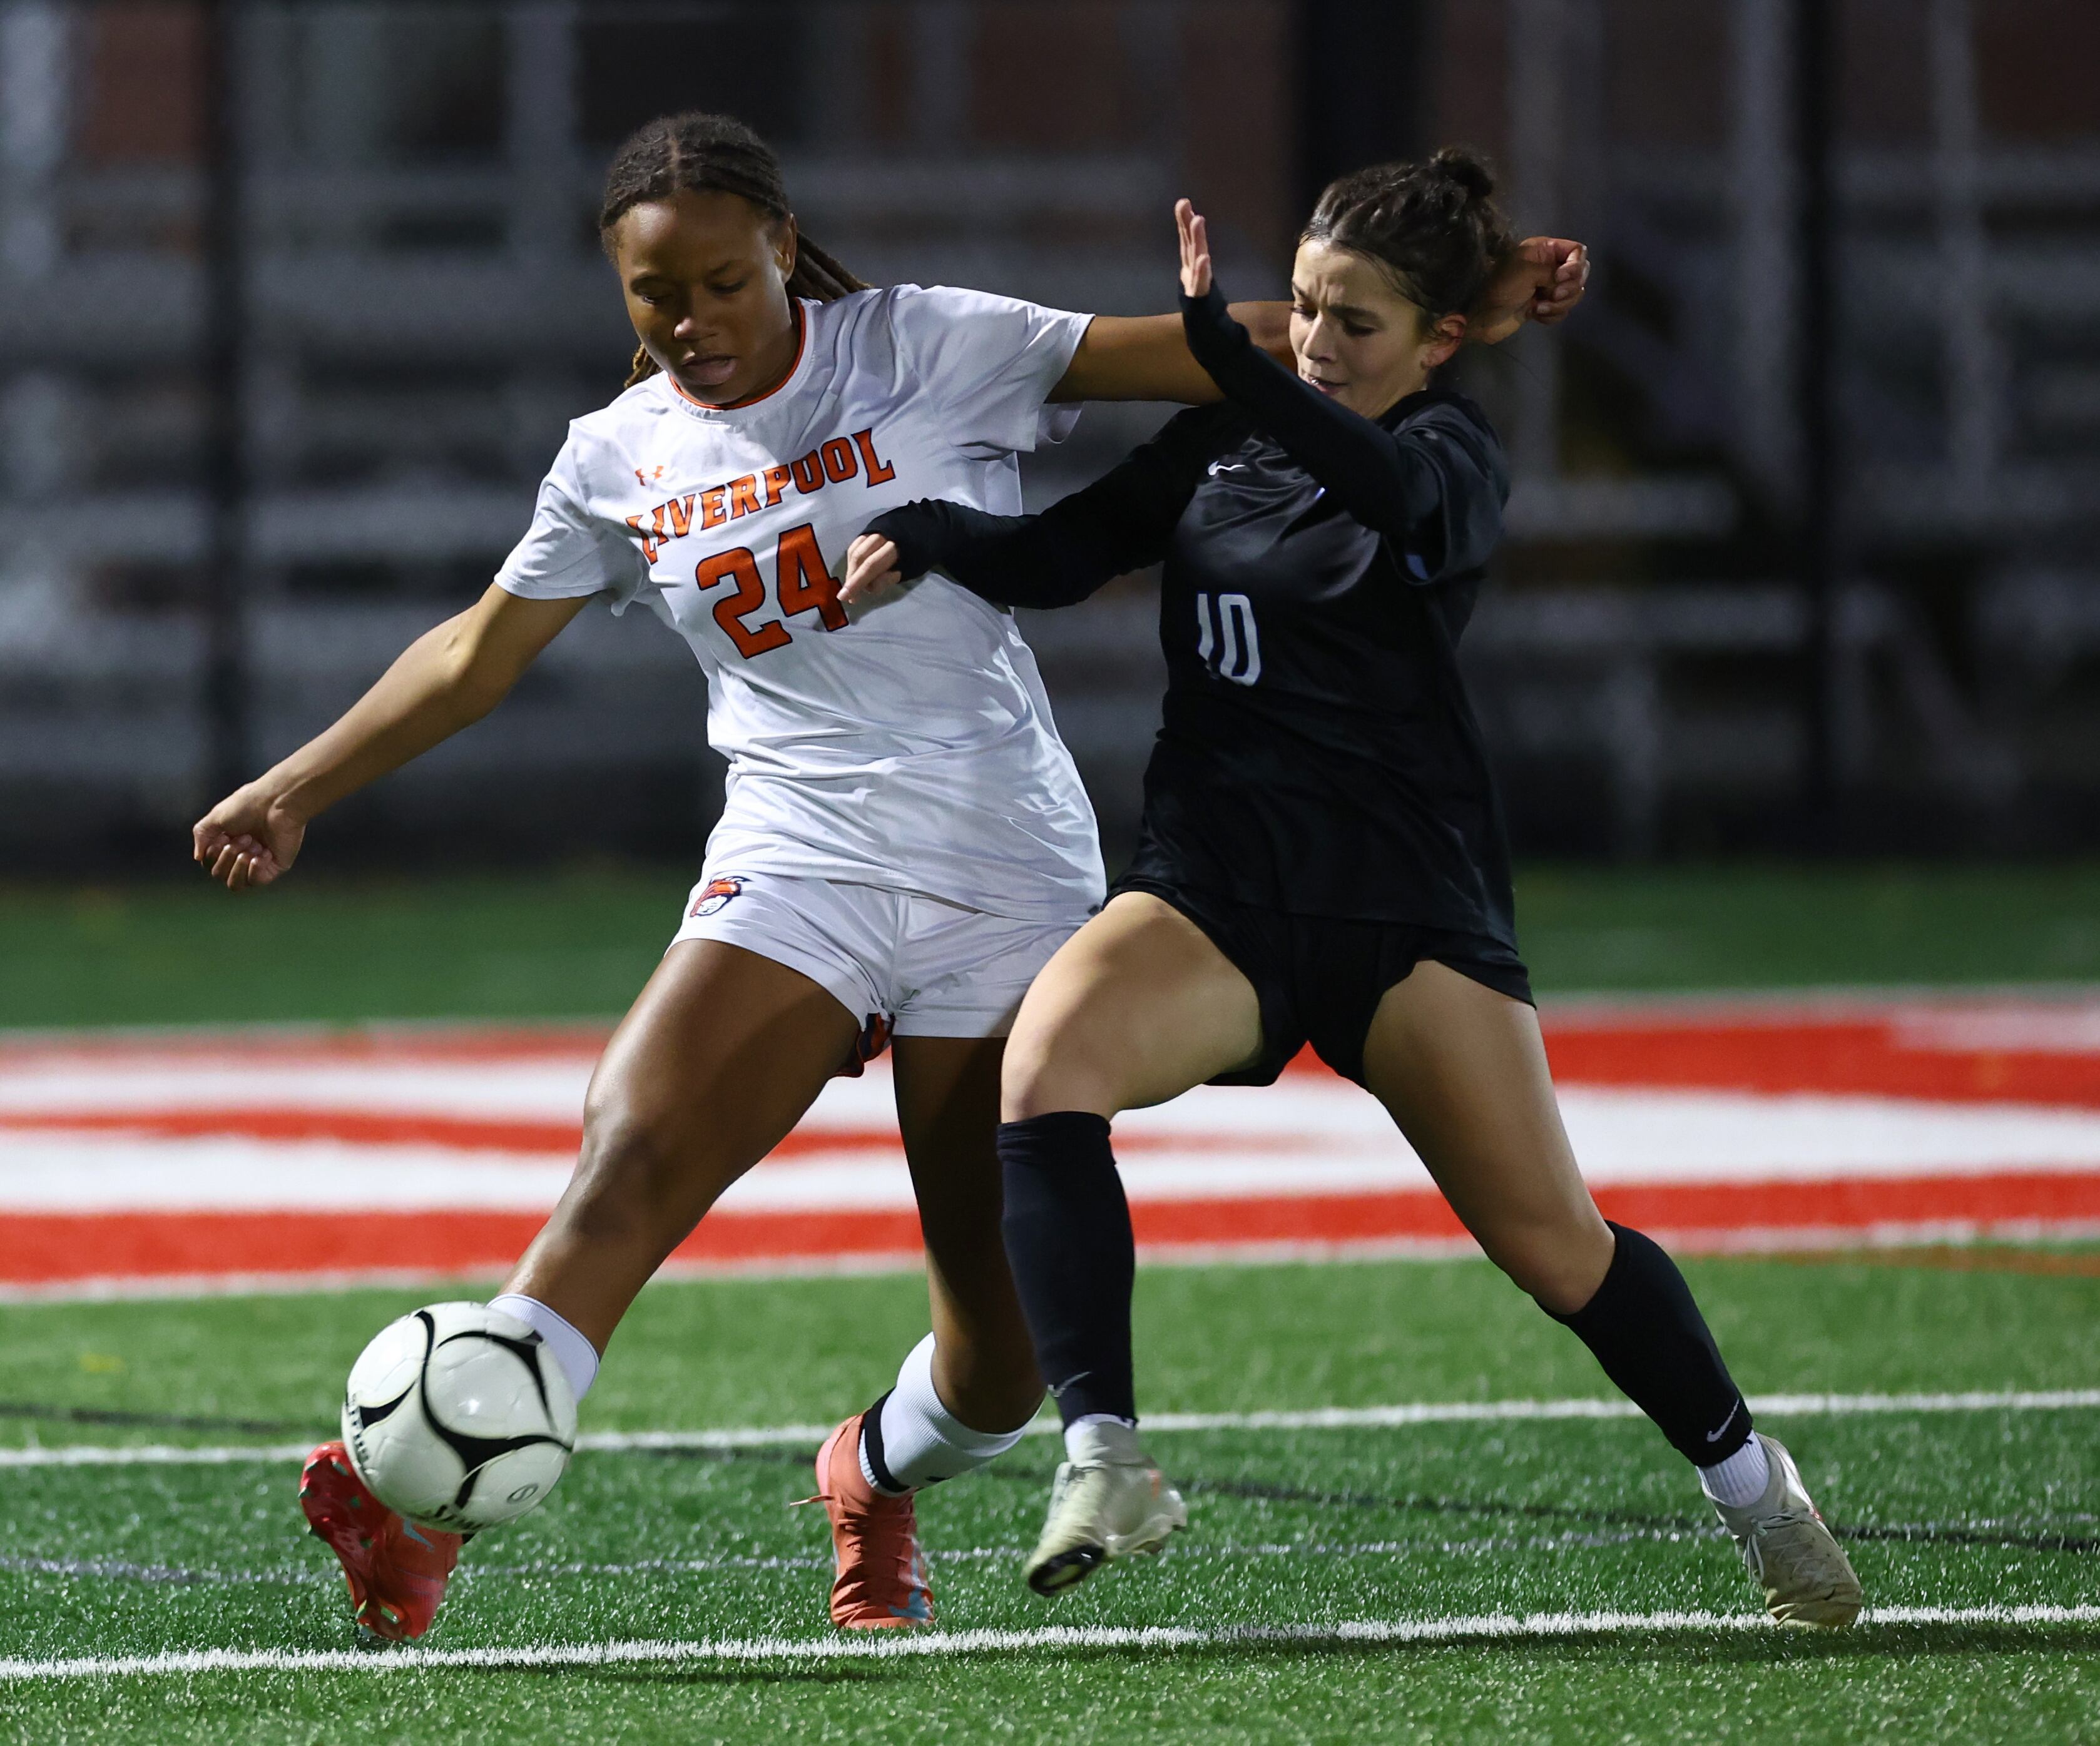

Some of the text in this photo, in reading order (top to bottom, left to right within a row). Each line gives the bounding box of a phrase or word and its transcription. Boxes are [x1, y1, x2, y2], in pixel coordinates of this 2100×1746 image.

[625, 427, 896, 565] LIVERPOOL
[695, 522, 849, 660] 24
[1196, 593, 1261, 687] 10
